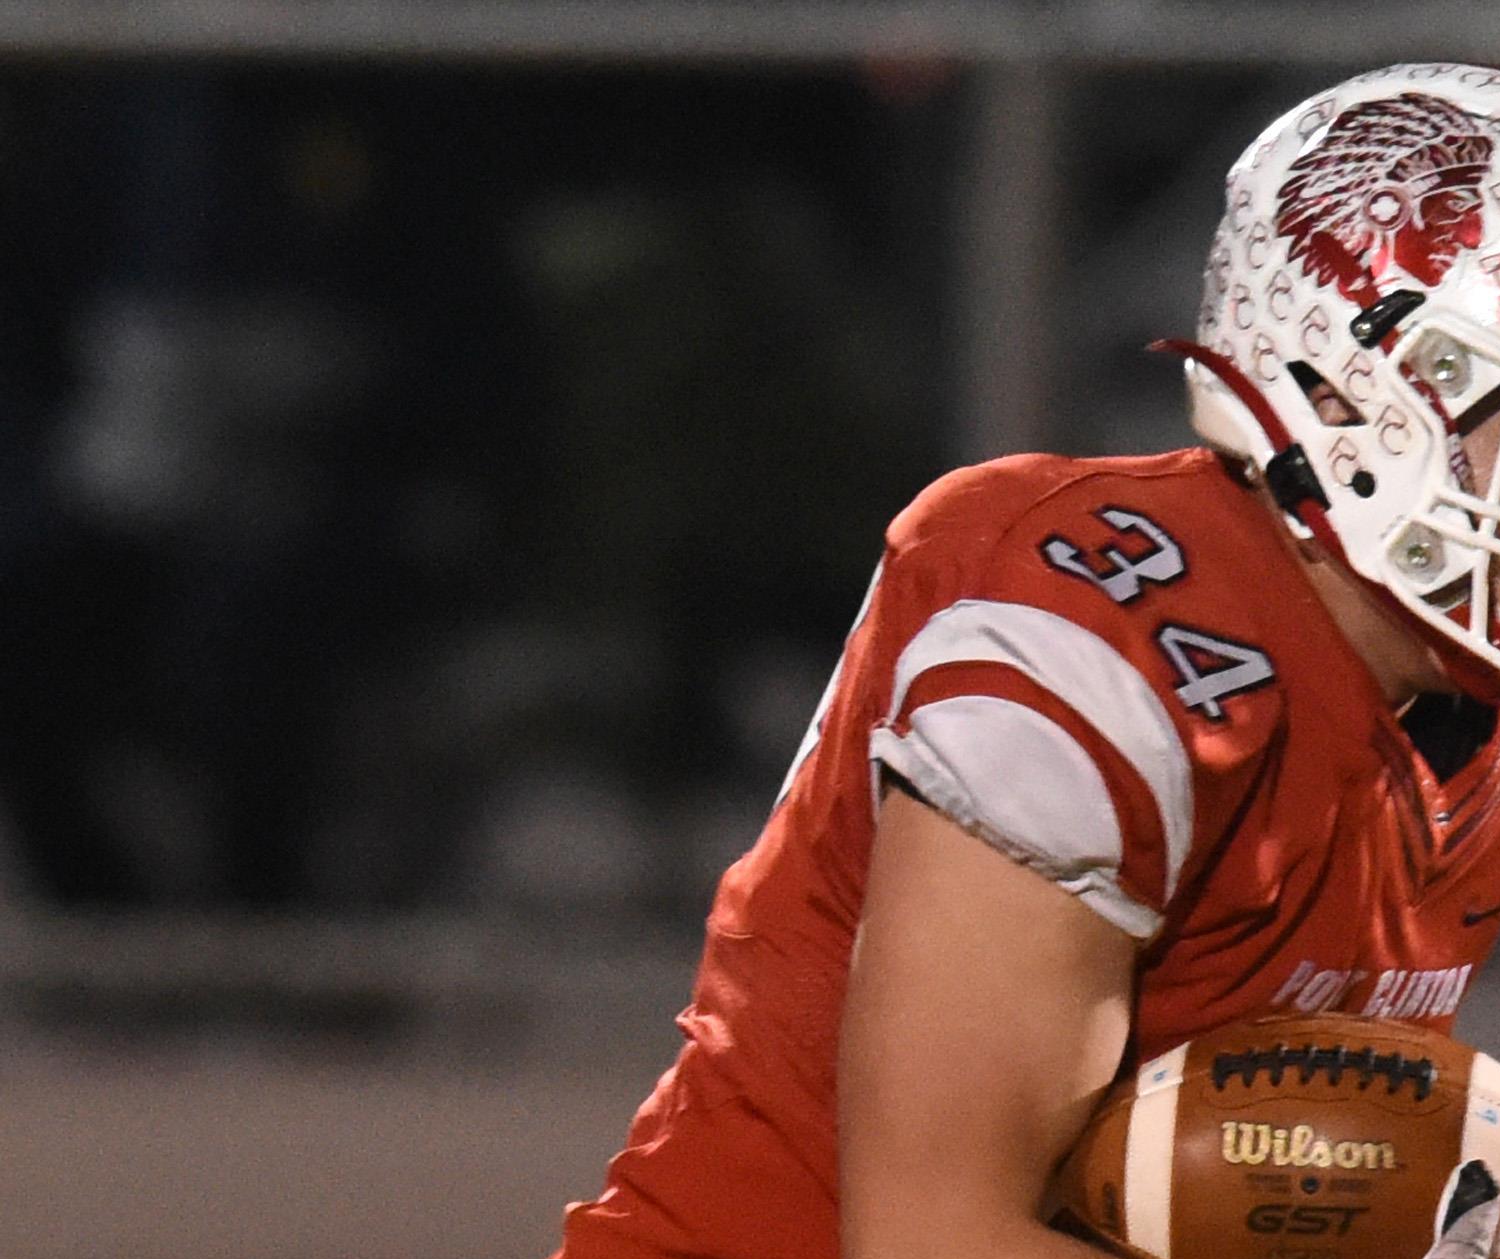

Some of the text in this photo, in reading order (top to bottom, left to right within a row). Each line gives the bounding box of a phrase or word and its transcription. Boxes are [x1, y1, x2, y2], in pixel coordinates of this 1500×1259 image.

[1038, 504, 1276, 721] 34
[1221, 1121, 1396, 1169] Wilson
[1247, 1203, 1371, 1236] GST
